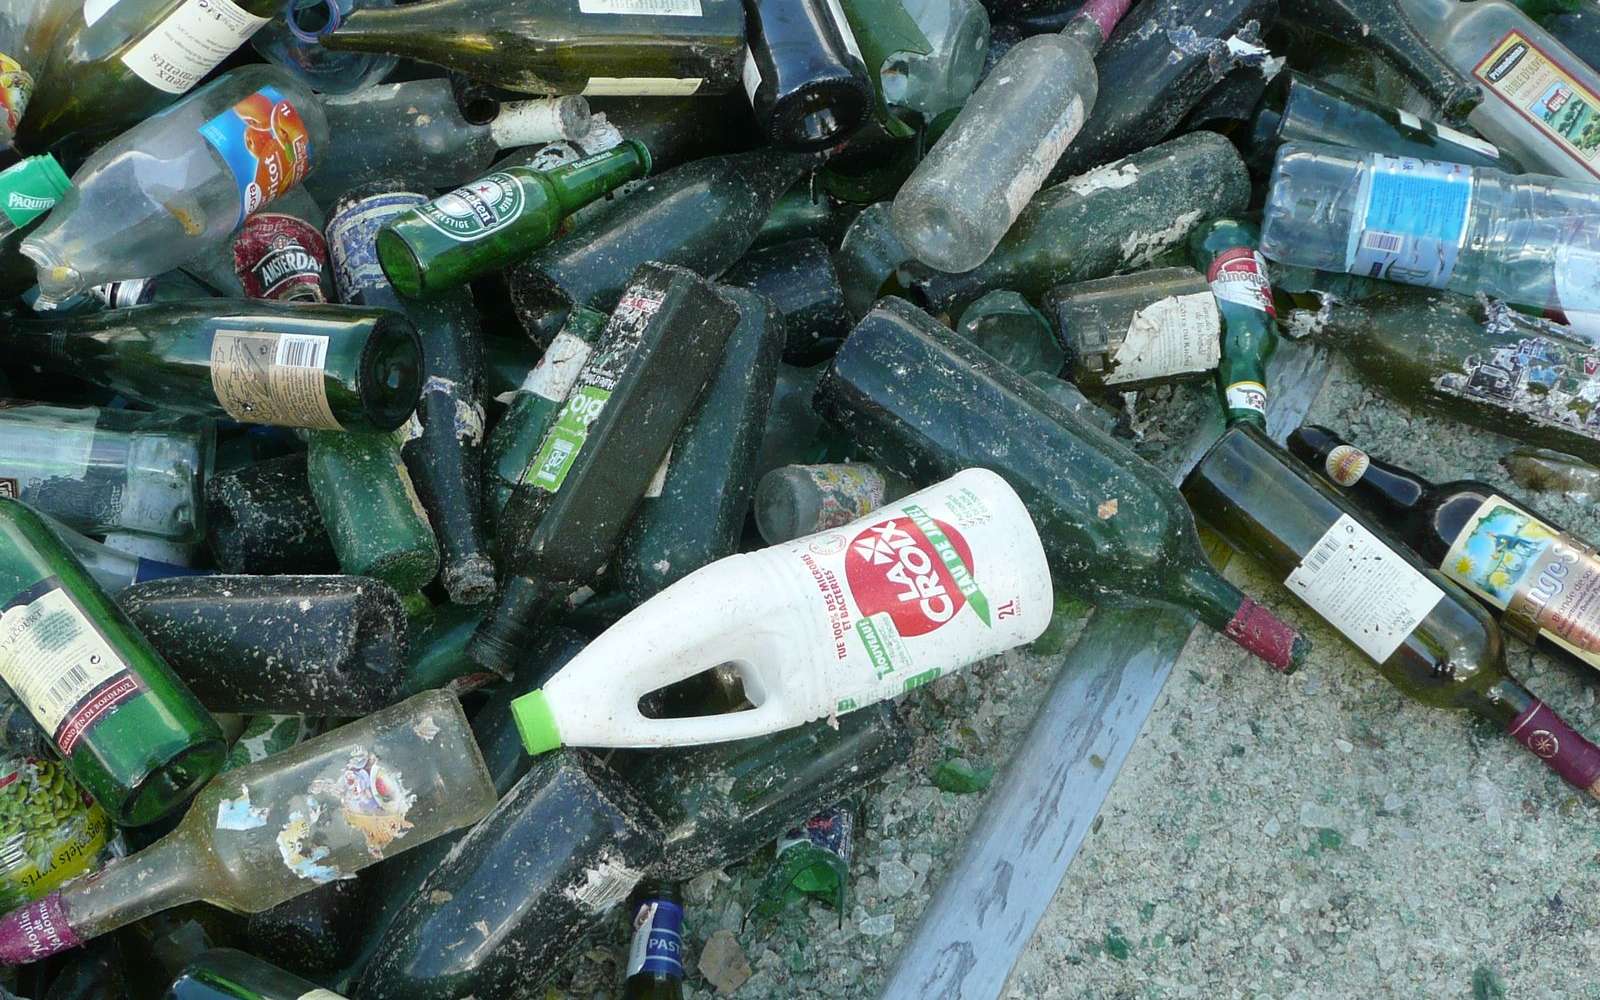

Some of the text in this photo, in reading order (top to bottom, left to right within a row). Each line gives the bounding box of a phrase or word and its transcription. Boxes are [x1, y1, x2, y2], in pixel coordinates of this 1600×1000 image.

[280, 103, 291, 117] 1L
[262, 252, 322, 287] AMSTERDA
[870, 521, 954, 623] CROIX
[936, 540, 955, 563] DE
[951, 563, 978, 596] EAU
[886, 566, 919, 602] LA
[824, 593, 836, 612] DES
[998, 599, 1015, 620] 2L
[842, 620, 852, 631] ET
[837, 643, 848, 660] TUE
[94, 682, 133, 711] BORDEAUX
[20, 911, 48, 956] Moulin
[34, 919, 43, 931] de
